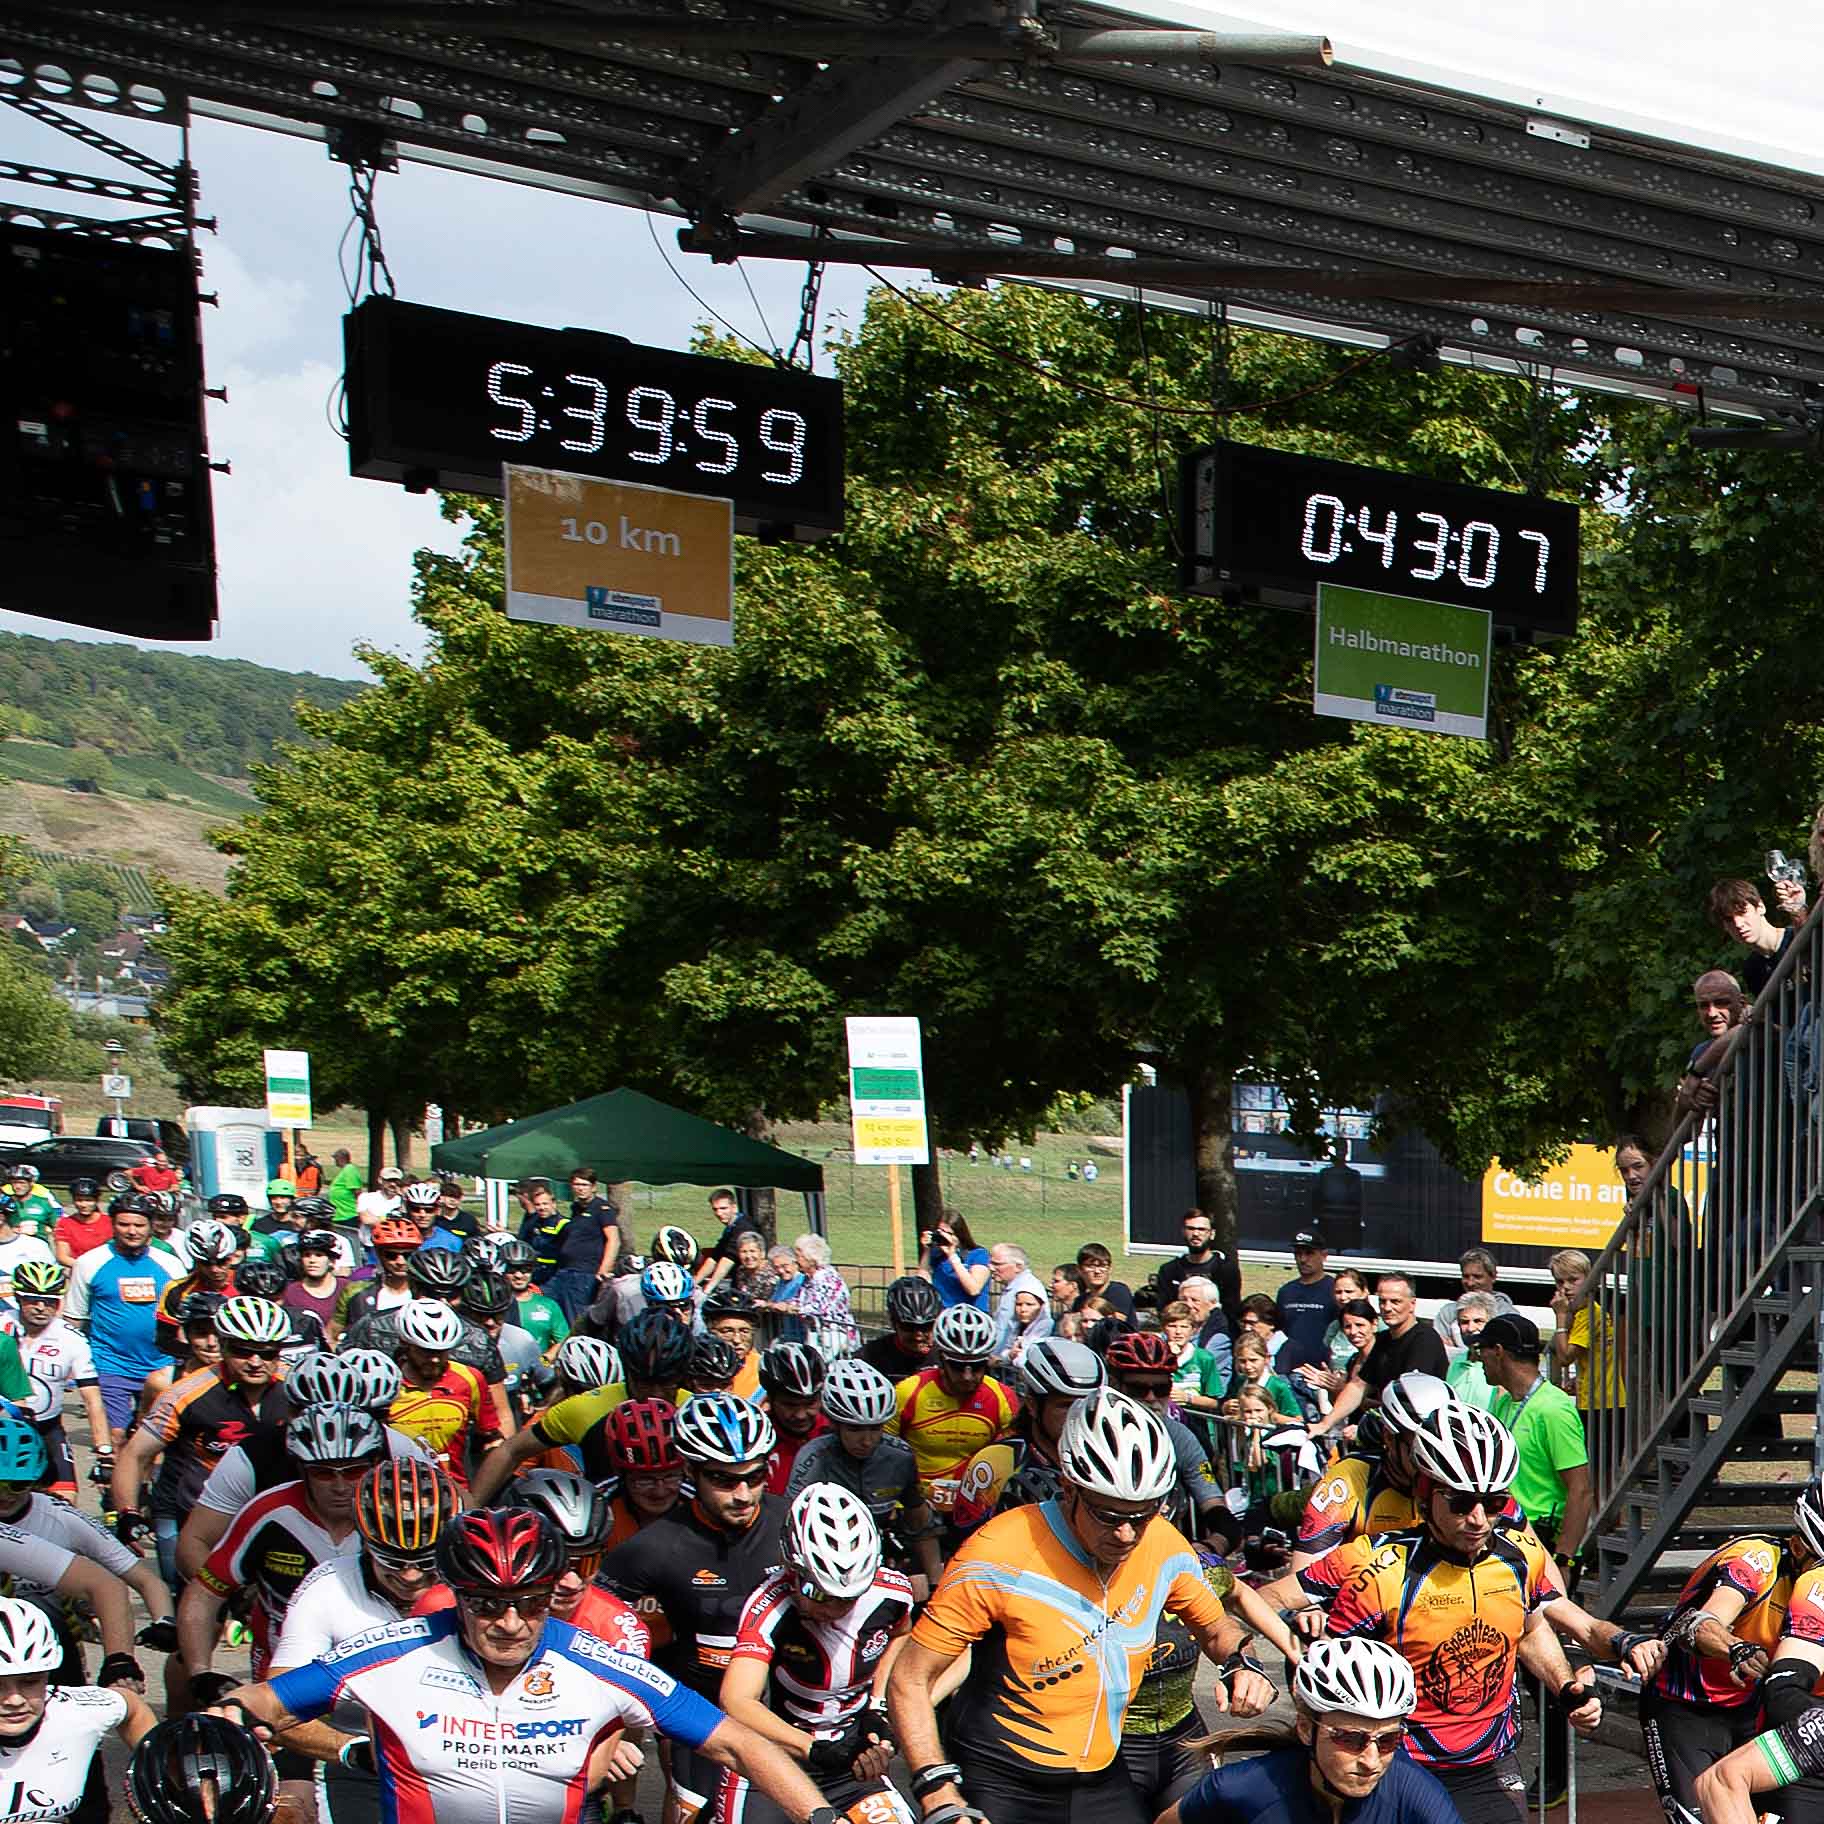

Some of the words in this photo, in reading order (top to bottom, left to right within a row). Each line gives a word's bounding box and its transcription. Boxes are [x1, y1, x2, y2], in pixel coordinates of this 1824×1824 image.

[488, 361, 806, 486] 5:39:59
[561, 518, 608, 544] 10
[620, 515, 680, 556] km
[1301, 492, 1550, 593] 0:43:07
[1329, 626, 1480, 667] Halbmarathon
[1569, 1175, 1592, 1201] in
[1598, 1184, 1627, 1203] an
[443, 1714, 591, 1741] INTERSPORT
[442, 1740, 499, 1756] PROFI
[502, 1741, 568, 1756] MARKT
[457, 1757, 539, 1770] Heilbronn
